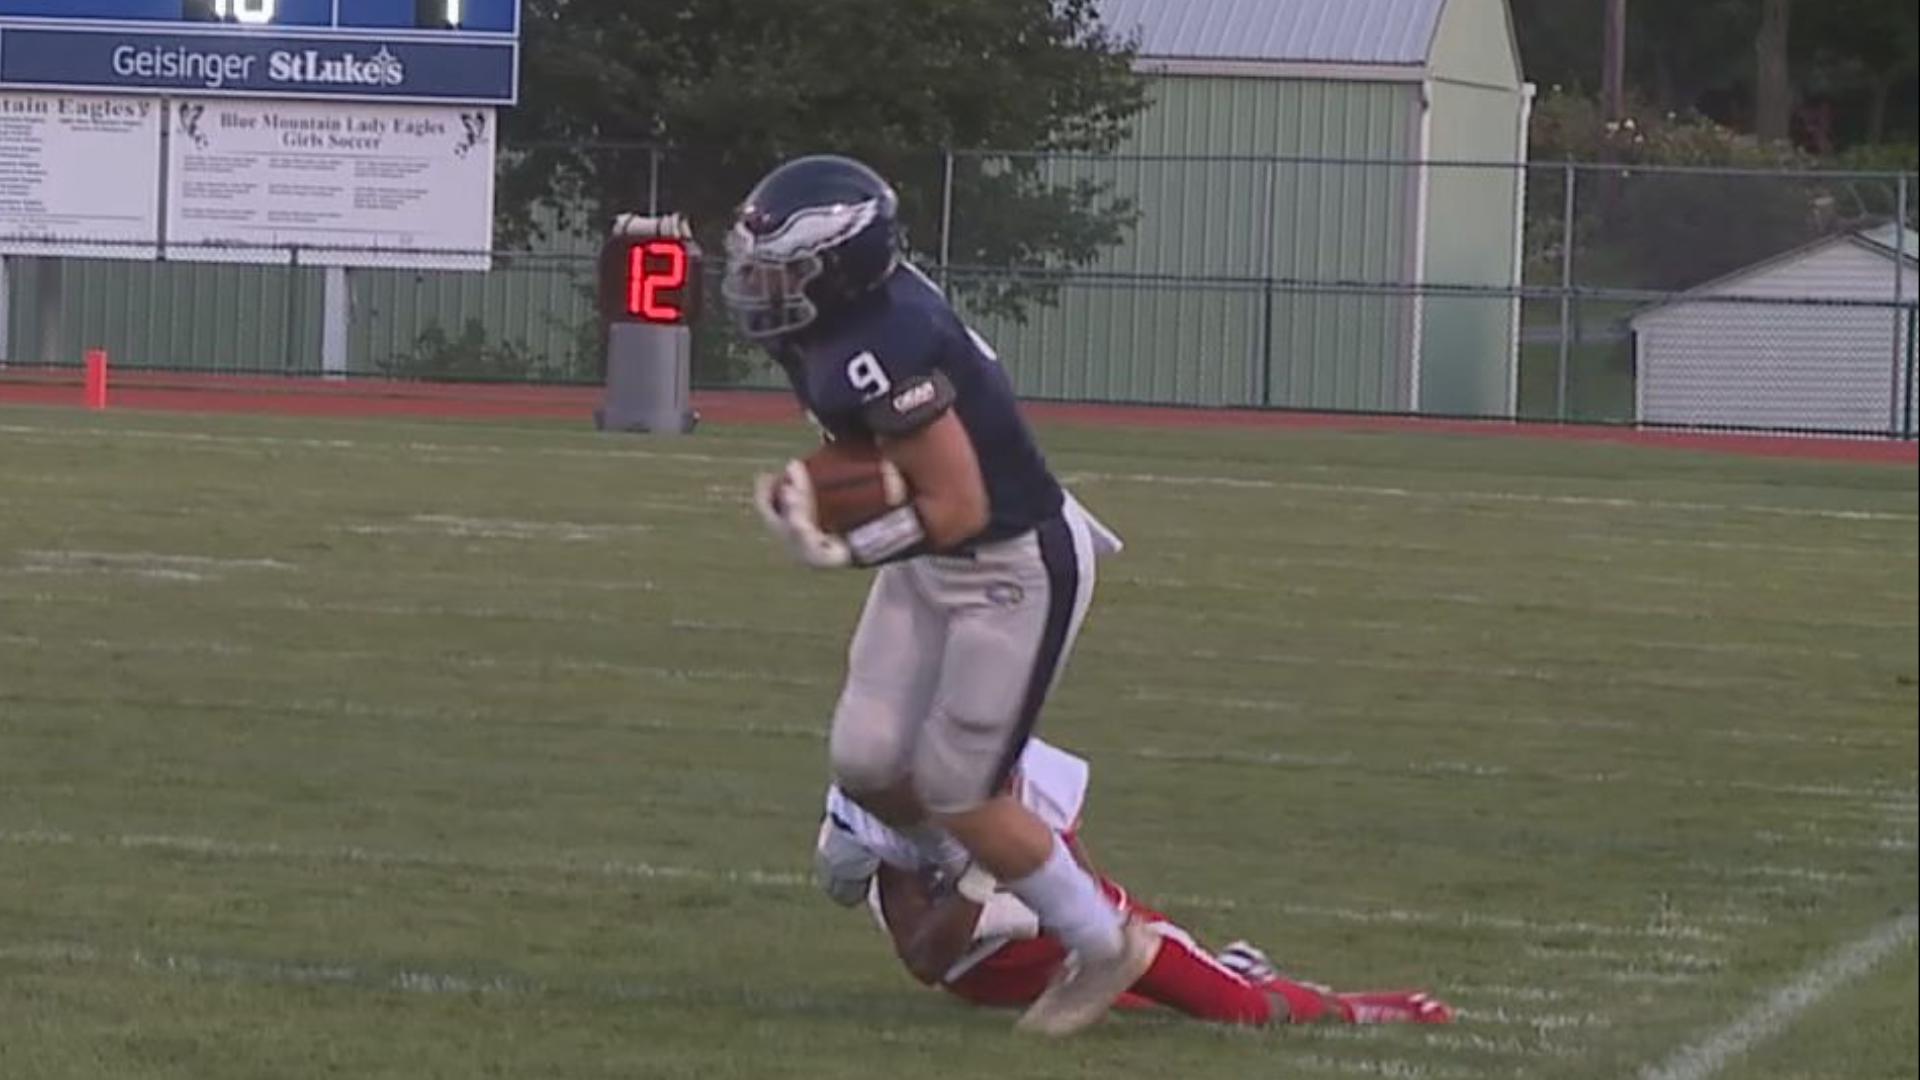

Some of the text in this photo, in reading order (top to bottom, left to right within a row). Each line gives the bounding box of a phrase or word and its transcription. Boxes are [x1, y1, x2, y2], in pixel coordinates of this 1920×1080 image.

[112, 45, 256, 88] Geisinger
[220, 112, 446, 136] Blue Mountain Lady Eagles
[282, 132, 381, 149] Girls Soccer
[629, 241, 686, 322] 12
[847, 351, 891, 401] 9
